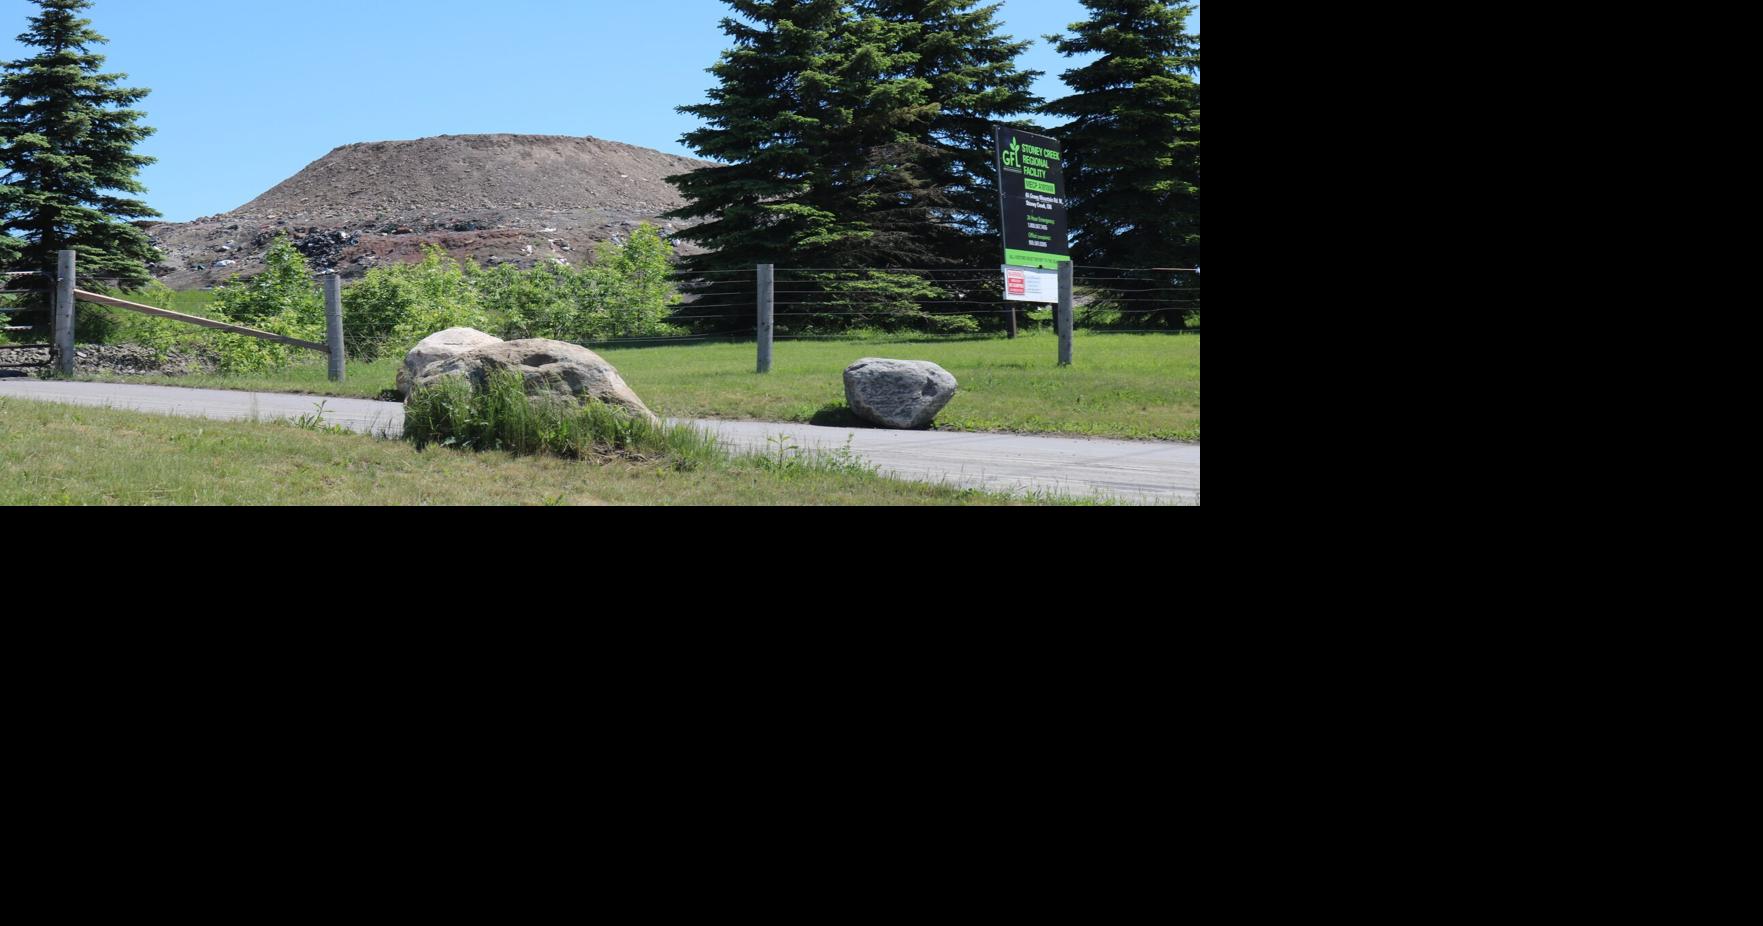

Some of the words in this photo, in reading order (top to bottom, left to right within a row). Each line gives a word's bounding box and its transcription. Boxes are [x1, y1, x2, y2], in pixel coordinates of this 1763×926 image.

[1003, 149, 1021, 168] GFL
[1022, 144, 1043, 156] STONEY
[1044, 149, 1060, 161] CREEK
[1023, 155, 1049, 169] REGIONAL
[1024, 166, 1046, 178] FACILITY
